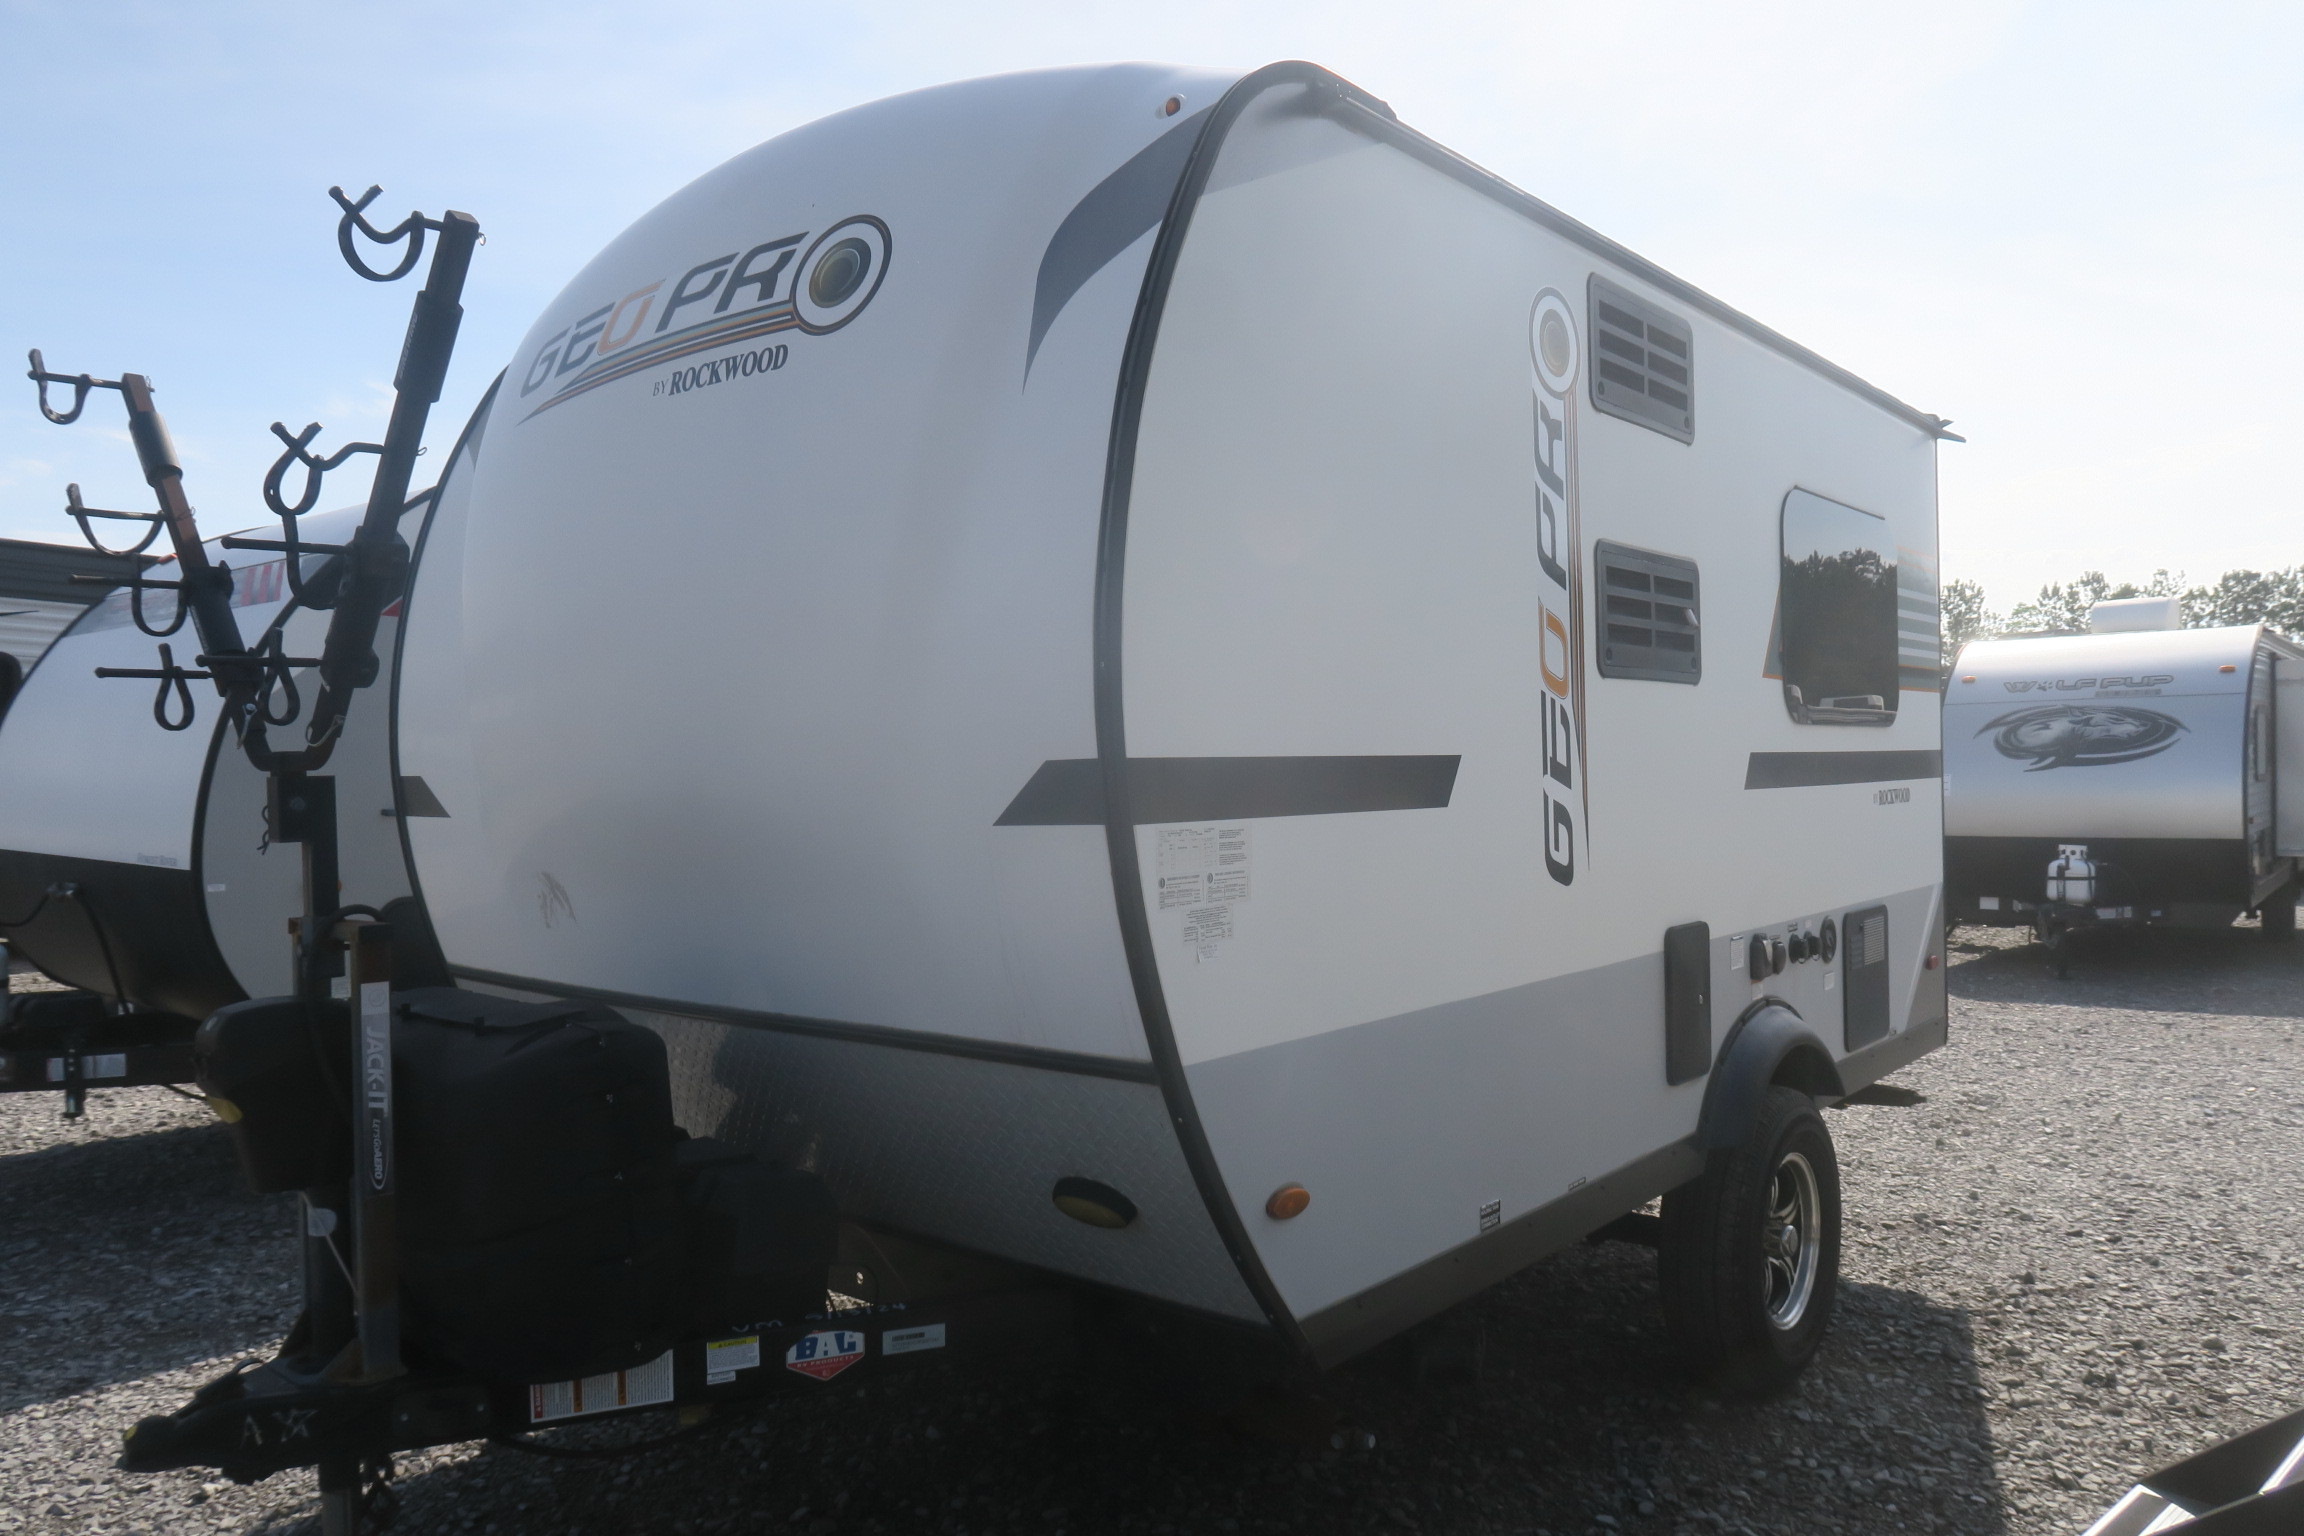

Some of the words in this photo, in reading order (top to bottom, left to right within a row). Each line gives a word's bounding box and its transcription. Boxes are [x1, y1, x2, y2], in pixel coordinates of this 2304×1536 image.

[520, 278, 667, 398] GEO
[655, 214, 892, 336] PRO
[652, 378, 671, 396] BY
[668, 344, 789, 396] ROCKWOOD
[1528, 286, 1580, 591] PRO
[2100, 675, 2174, 689] PUP
[1538, 598, 1574, 887] GEO
[366, 1025, 388, 1113] JACK-IT
[795, 1332, 857, 1360] BAL
[810, 1355, 854, 1366] PRODUCTS
